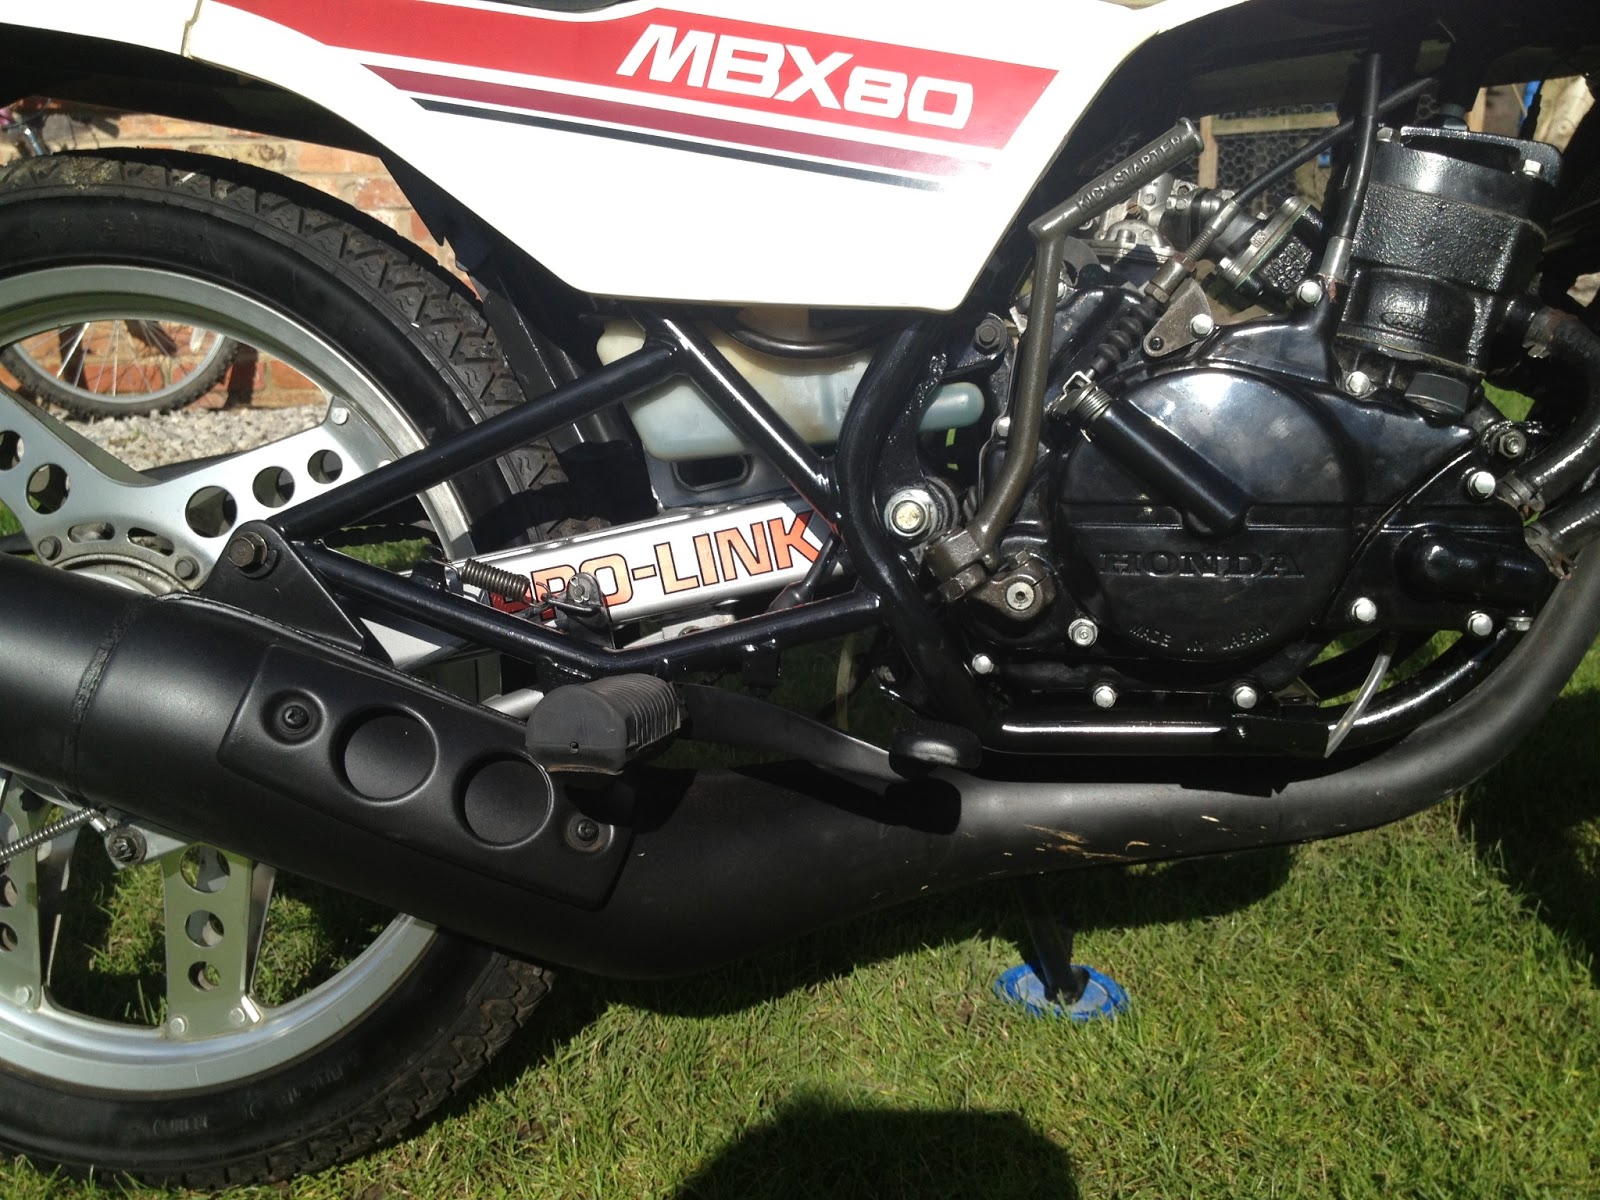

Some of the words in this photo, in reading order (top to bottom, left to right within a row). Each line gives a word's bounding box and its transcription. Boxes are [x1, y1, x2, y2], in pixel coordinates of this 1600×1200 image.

[615, 23, 974, 130] MBX80
[1077, 181, 1112, 213] KICK
[1113, 135, 1182, 188] STARTER
[1099, 551, 1305, 579] HONDA
